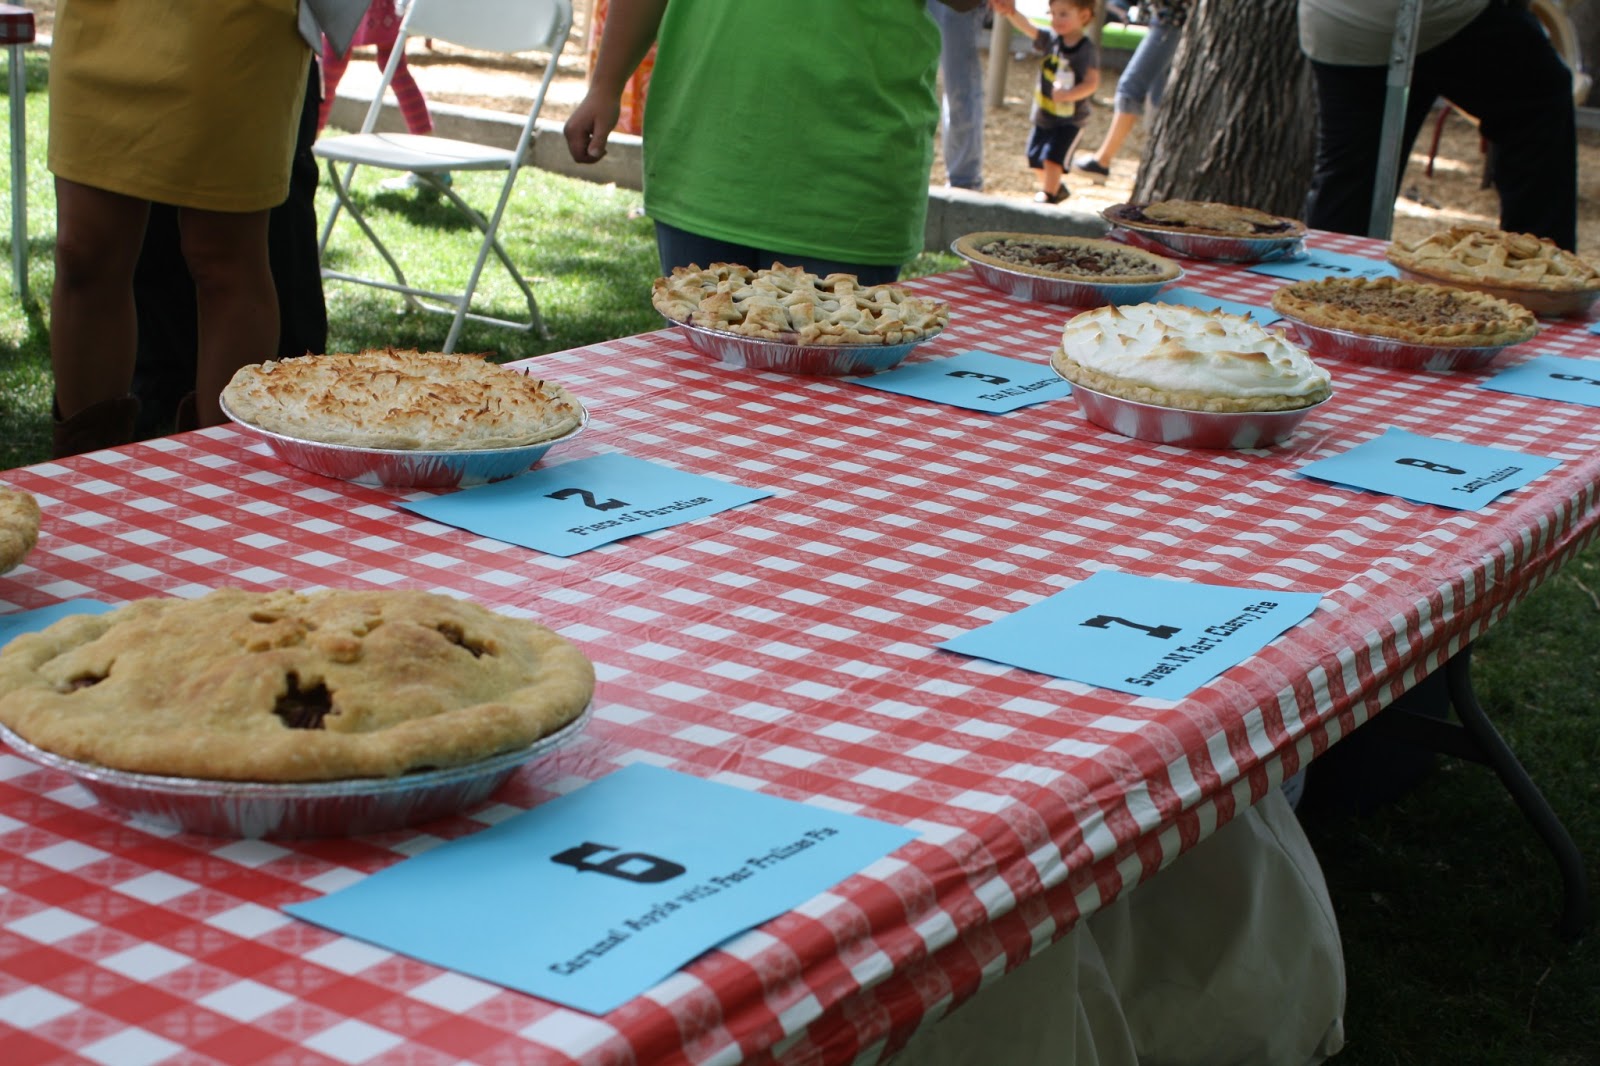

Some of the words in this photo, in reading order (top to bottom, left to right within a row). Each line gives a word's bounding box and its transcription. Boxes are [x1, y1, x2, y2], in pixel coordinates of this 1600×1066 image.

[944, 370, 1011, 386] 3
[1394, 457, 1467, 475] 8
[542, 487, 632, 512] 2
[565, 520, 623, 536] Piece
[618, 513, 641, 523] of
[632, 496, 714, 518] Paradise
[1242, 601, 1279, 615] Pie
[1078, 614, 1183, 640] 7
[1204, 612, 1262, 637] Cherry
[1162, 652, 1196, 663] N
[1175, 636, 1223, 655] Tart
[1124, 662, 1183, 687] Sweet
[549, 841, 687, 884] 6
